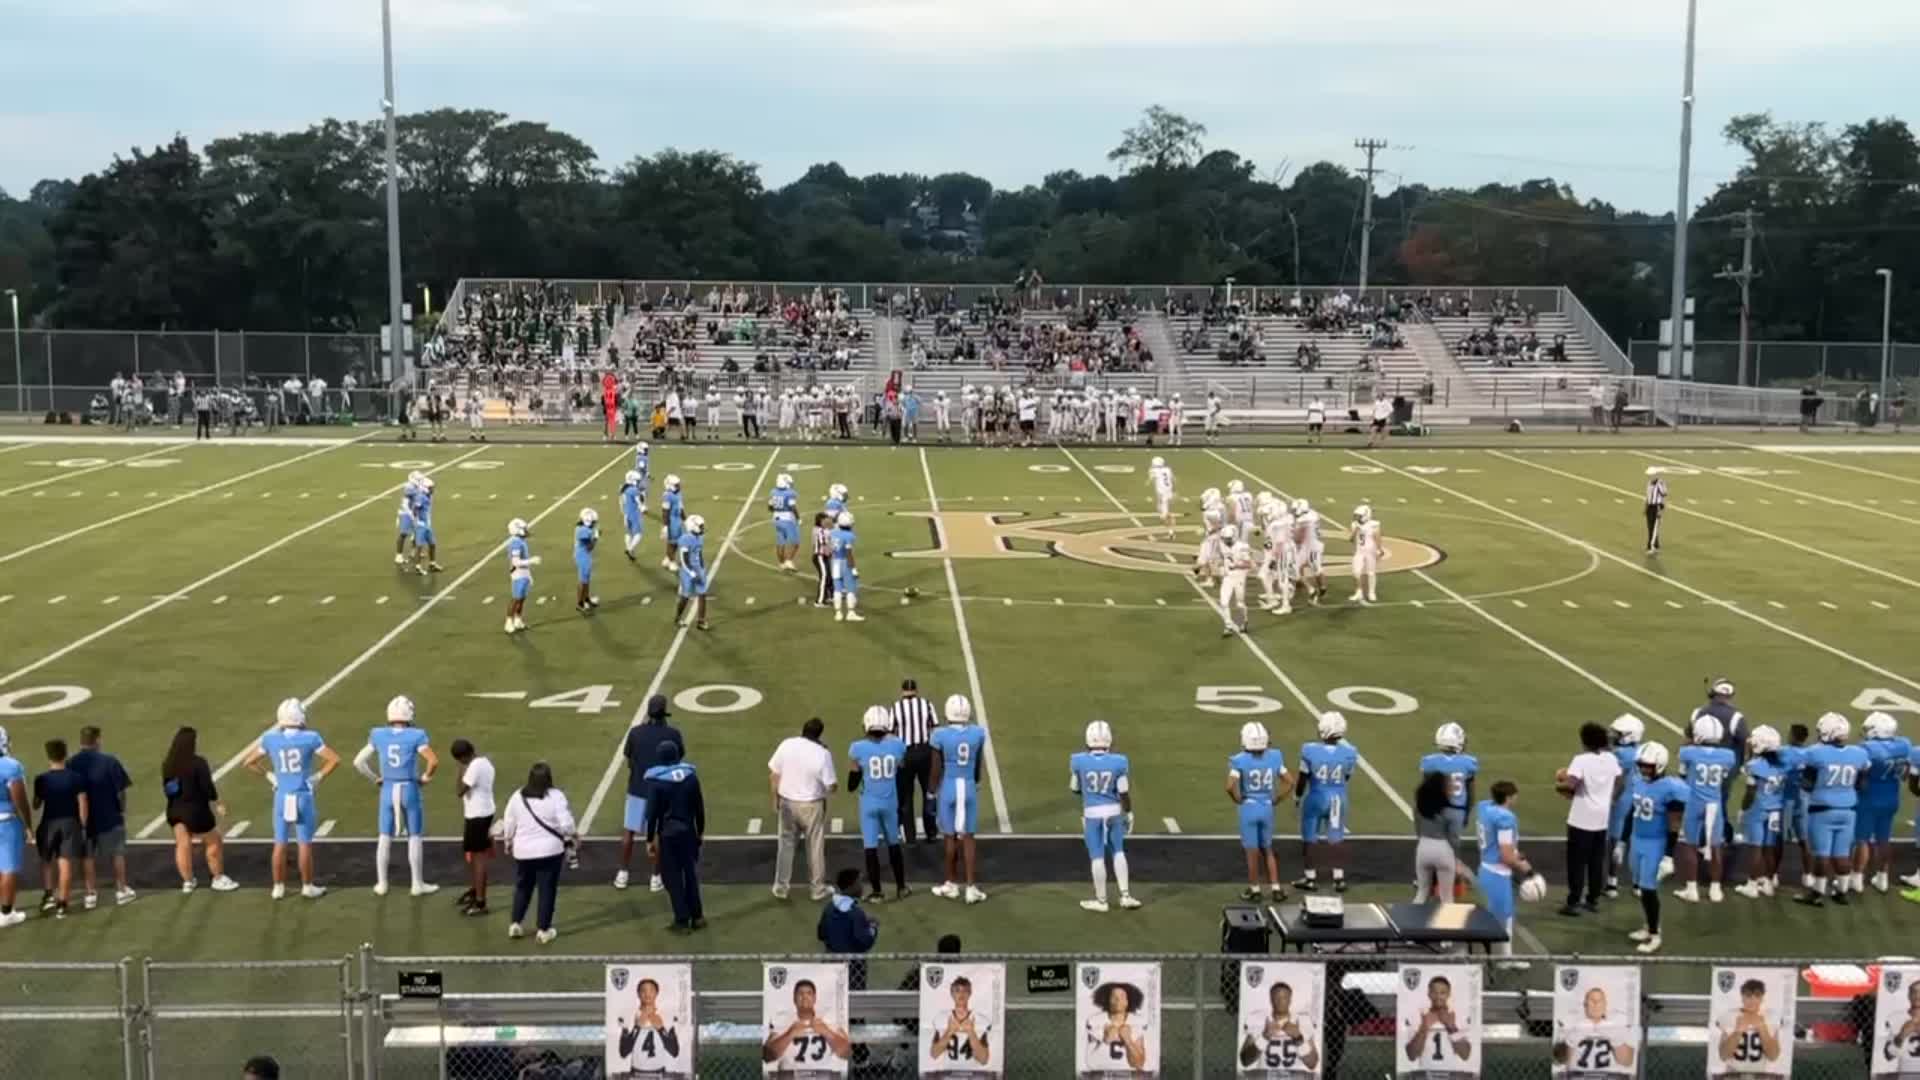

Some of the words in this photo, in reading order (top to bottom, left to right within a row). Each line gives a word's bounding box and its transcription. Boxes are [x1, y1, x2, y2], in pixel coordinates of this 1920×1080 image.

[279, 748, 302, 773] 12
[387, 744, 401, 768] 5
[956, 743, 970, 766] 9
[869, 754, 896, 780] 80
[1315, 764, 1342, 785] 44
[1695, 763, 1722, 786] 33
[1826, 765, 1857, 787] 70
[1085, 771, 1112, 794] 37
[1248, 769, 1273, 791] 34
[1449, 772, 1463, 796] 5
[413, 975, 427, 985] NO
[1029, 977, 1068, 988] STANDING
[1041, 969, 1055, 978] NO
[401, 985, 441, 995] STANDING
[641, 1030, 656, 1058] 4
[792, 1035, 827, 1062] 73
[1264, 1039, 1299, 1068] 55
[1431, 1031, 1444, 1061] 1
[1577, 1039, 1611, 1069] 72
